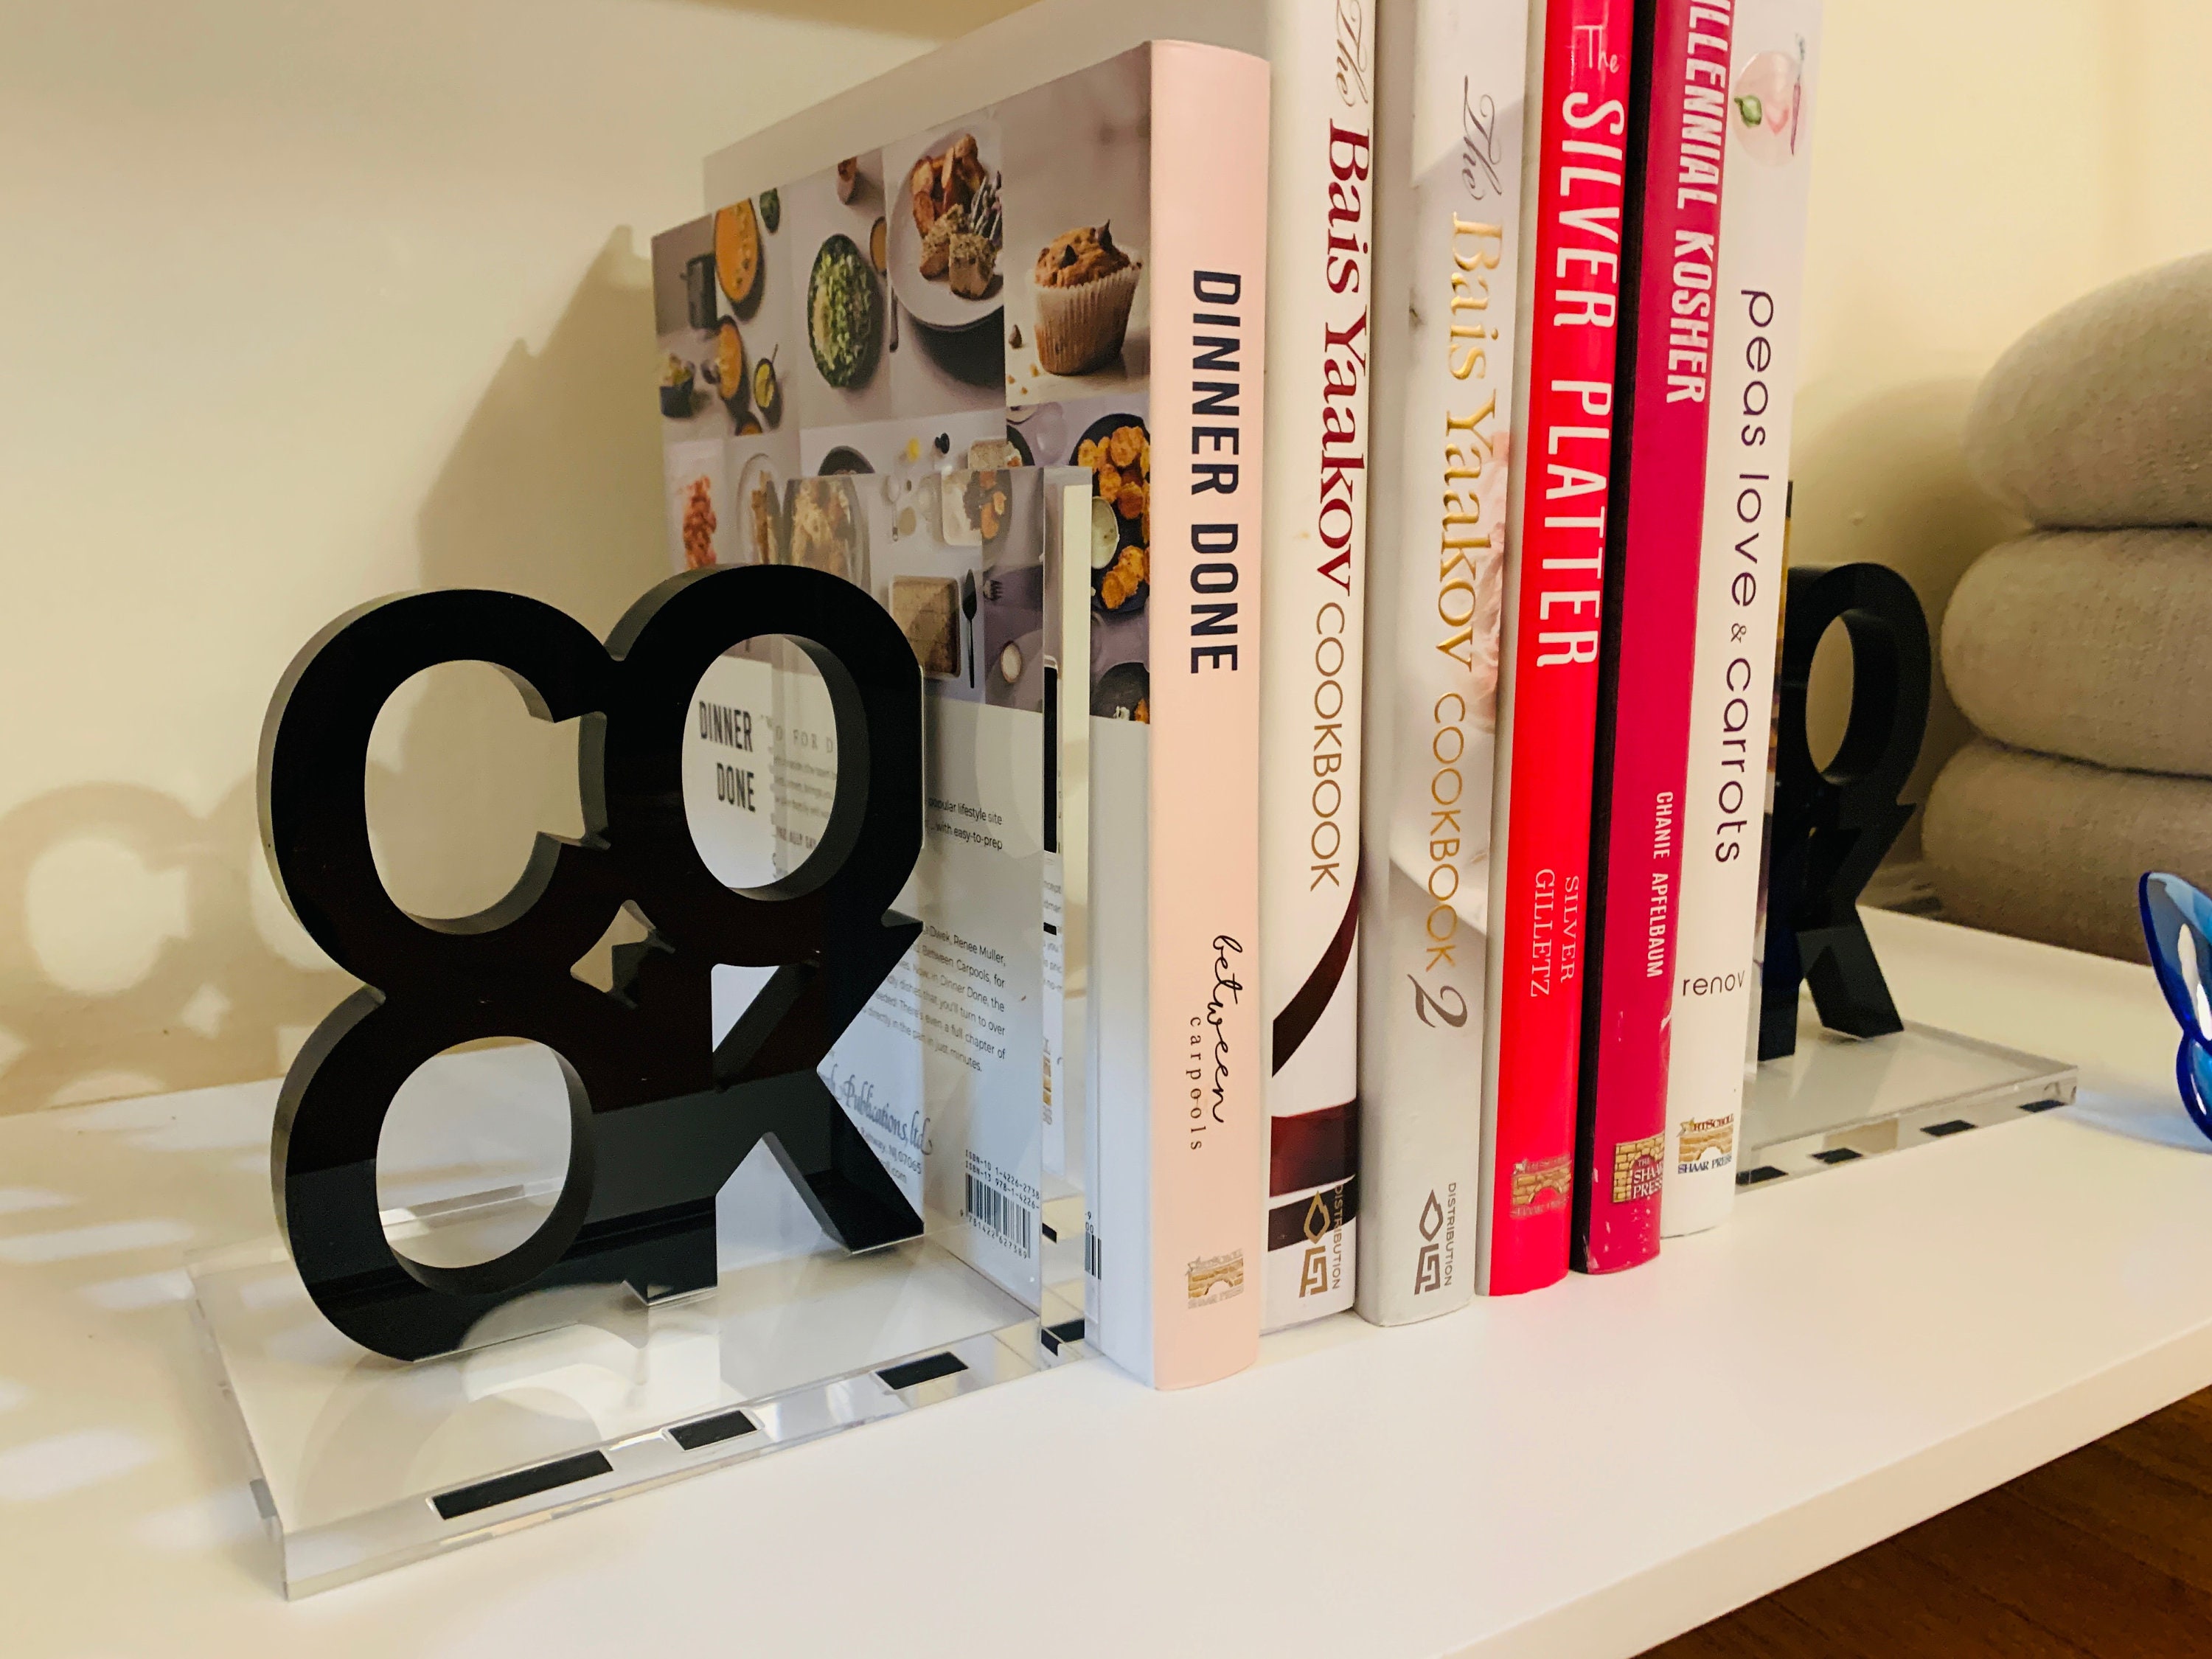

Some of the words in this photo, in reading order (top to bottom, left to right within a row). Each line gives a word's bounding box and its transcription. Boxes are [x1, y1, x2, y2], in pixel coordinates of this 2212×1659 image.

[1574, 24, 1620, 74] The
[1462, 75, 1502, 201] The
[1677, 0, 1731, 210] ILLENNIAL
[1326, 118, 1369, 293] Bais
[1554, 91, 1624, 329] SILVER
[1448, 211, 1503, 380] Bais
[1666, 229, 1714, 405] KOSHER
[1191, 270, 1242, 495] DINNER
[1741, 289, 1774, 447] peas
[1317, 305, 1367, 596] Yaakov
[1436, 389, 1496, 672] Yaakov
[1537, 380, 1612, 667] PLATTER
[1731, 474, 1770, 607] love
[1190, 524, 1239, 674] DONE
[1731, 623, 1747, 644] &
[699, 700, 754, 753] DINNER
[1310, 602, 1345, 892] COOKBOOK
[1715, 658, 1751, 863] carrots
[717, 762, 756, 813] DONE
[953, 827, 1003, 851] easy-to-prep
[958, 803, 987, 822] lifestyle
[988, 811, 1003, 825] site
[1426, 692, 1466, 973] COOKBOOK
[1653, 791, 1674, 859] CHANIE
[953, 934, 978, 954] Renee
[979, 945, 1006, 967] Muller,
[956, 959, 992, 985] Carpools,
[993, 973, 1005, 989] for
[1531, 869, 1555, 997] GILLETZ
[1560, 875, 1579, 983] SILVER
[1646, 872, 1669, 978] APFELBAUM
[960, 1006, 976, 1023] turn
[978, 1015, 987, 1028] to
[988, 1020, 1005, 1037] over
[967, 986, 990, 1008] Done,
[991, 997, 1005, 1012] the
[1207, 935, 1242, 1124] between
[1408, 974, 1467, 1028] 2
[1683, 970, 1745, 996] renov
[964, 1032, 995, 1055] chapter
[997, 1048, 1006, 1060] of
[1186, 1016, 1206, 1151] carpools
[965, 1149, 992, 1171] ISBN-10
[965, 1160, 992, 1183] ISBN-13
[1332, 1183, 1344, 1290] DISTRIBUTION
[1443, 1182, 1457, 1287] DISTRIBUTION
